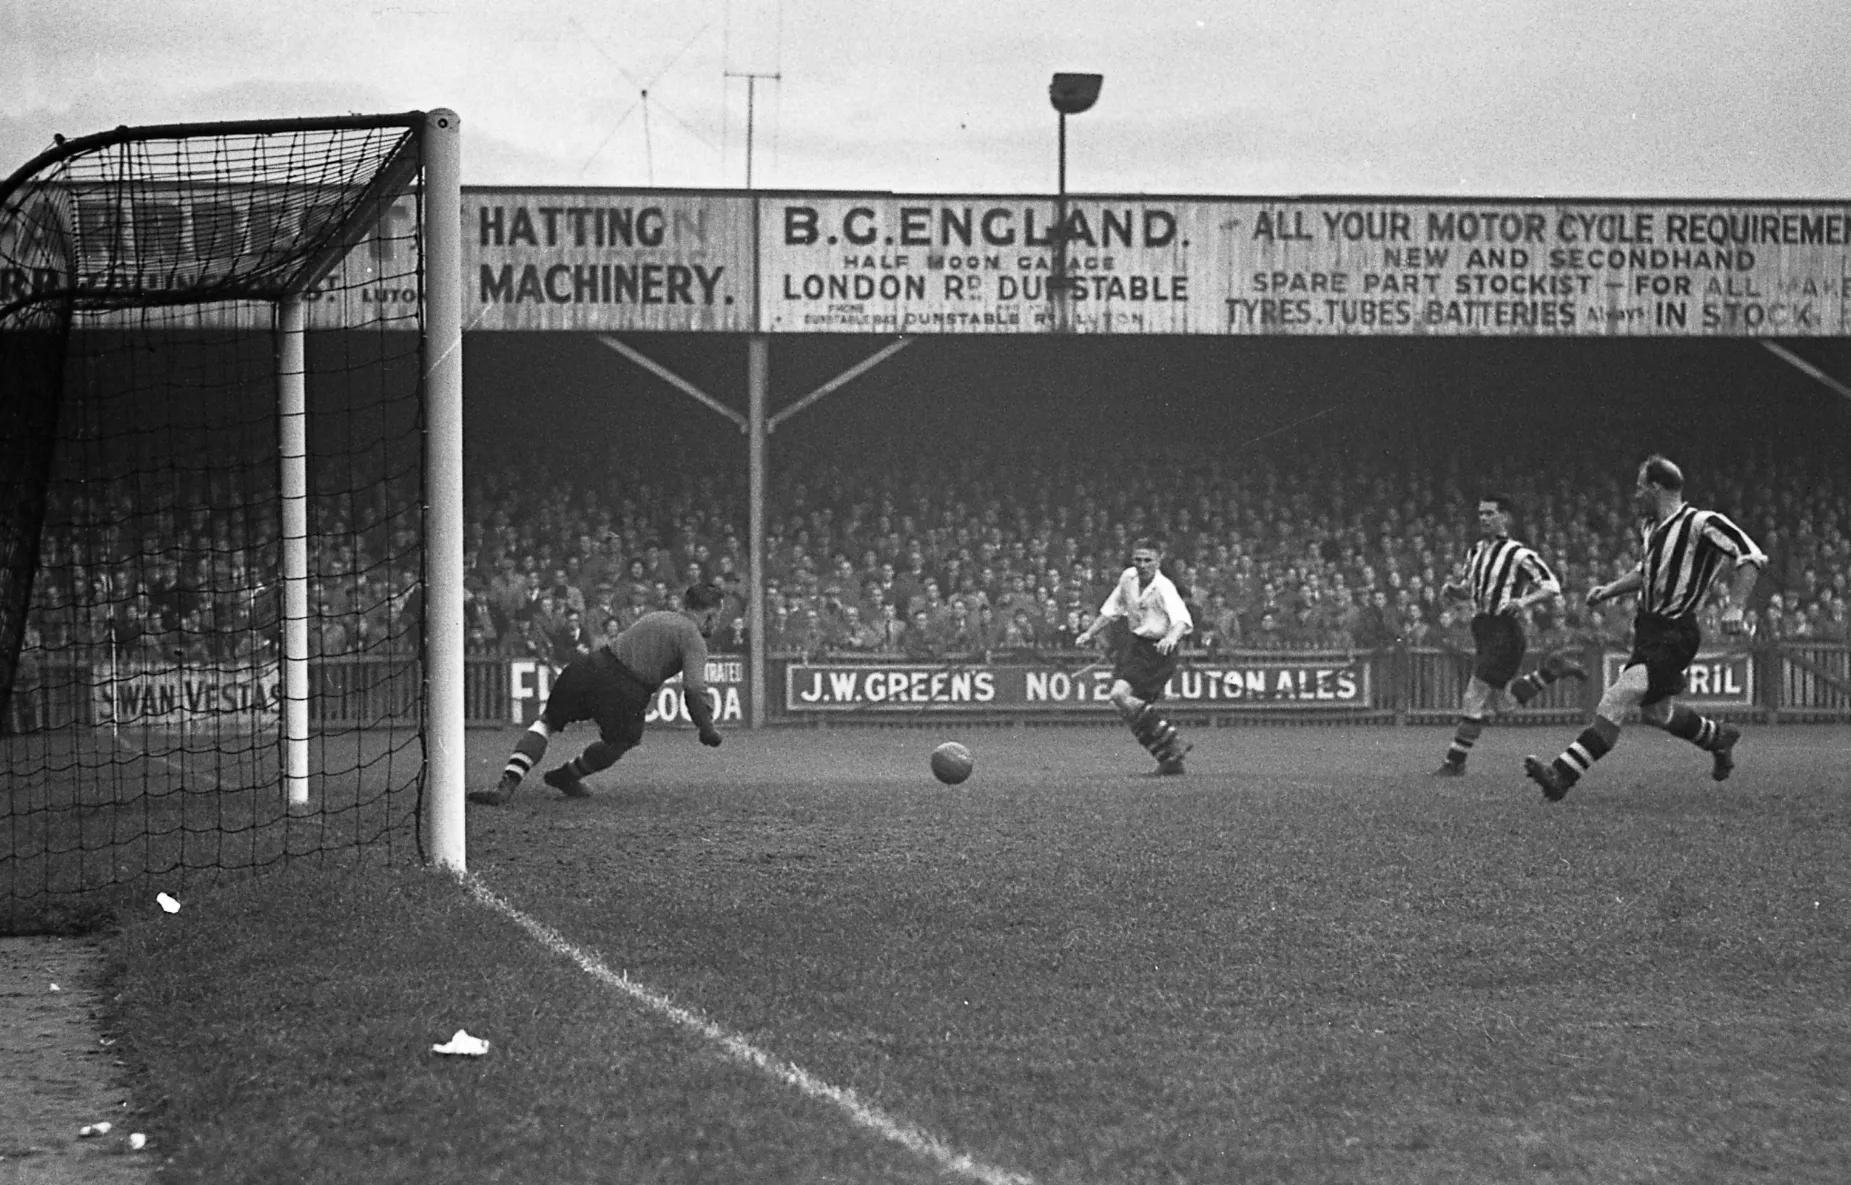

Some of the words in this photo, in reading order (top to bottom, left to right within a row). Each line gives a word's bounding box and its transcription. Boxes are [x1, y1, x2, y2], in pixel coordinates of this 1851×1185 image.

[479, 206, 665, 248] HATTING
[1253, 210, 1313, 242] ALL
[1323, 210, 1411, 242] YOUR
[1427, 211, 1546, 244] MOTOR
[1556, 212, 1654, 245] CYCLE
[844, 255, 910, 271] HALF
[928, 253, 1000, 272] MOON
[1018, 256, 1115, 272] GAAGE
[1384, 247, 1450, 269] NEW
[1466, 248, 1530, 270] AND
[1549, 249, 1756, 272] SECONDHAND
[363, 288, 418, 303] LUTO
[480, 264, 735, 306] MACHINERY.
[783, 274, 926, 302] LONDON
[1253, 272, 1348, 293] SPARE
[1363, 273, 1442, 294] PART
[1455, 274, 1592, 295] STOCKIST
[1636, 275, 1692, 296] FOR
[1707, 277, 1761, 297] ALL
[903, 312, 1020, 326] DUNSTABLE
[1425, 301, 1576, 328] BATTERIES
[1656, 302, 1688, 328] IN
[98, 681, 175, 719] SWAN
[184, 678, 282, 716] VESTAS
[1163, 669, 1265, 701] LUTON
[1276, 671, 1358, 700] ALES
